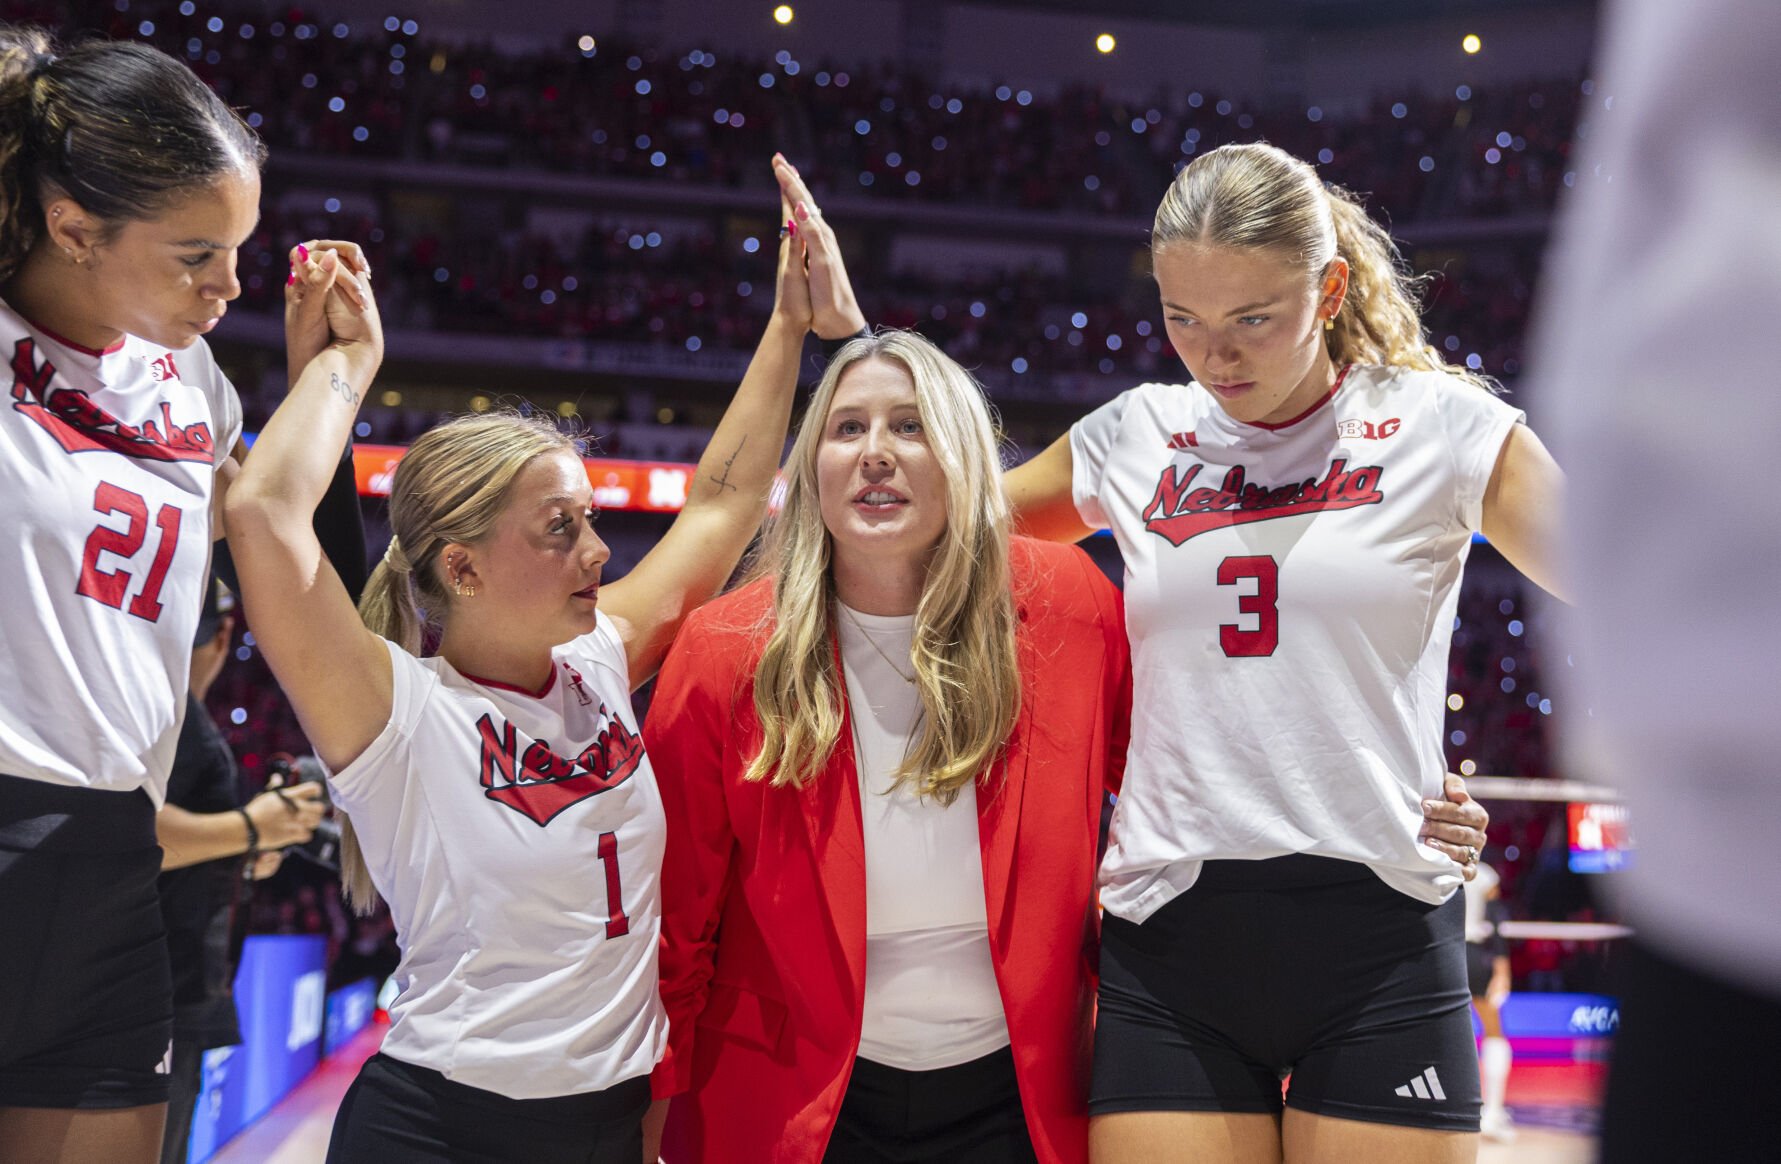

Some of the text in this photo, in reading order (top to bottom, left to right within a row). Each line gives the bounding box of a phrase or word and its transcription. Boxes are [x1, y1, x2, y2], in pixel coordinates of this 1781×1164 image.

[1143, 459, 1383, 522] Nebraska
[76, 480, 182, 623] 21
[1217, 555, 1279, 657] 3
[597, 831, 630, 939] 1
